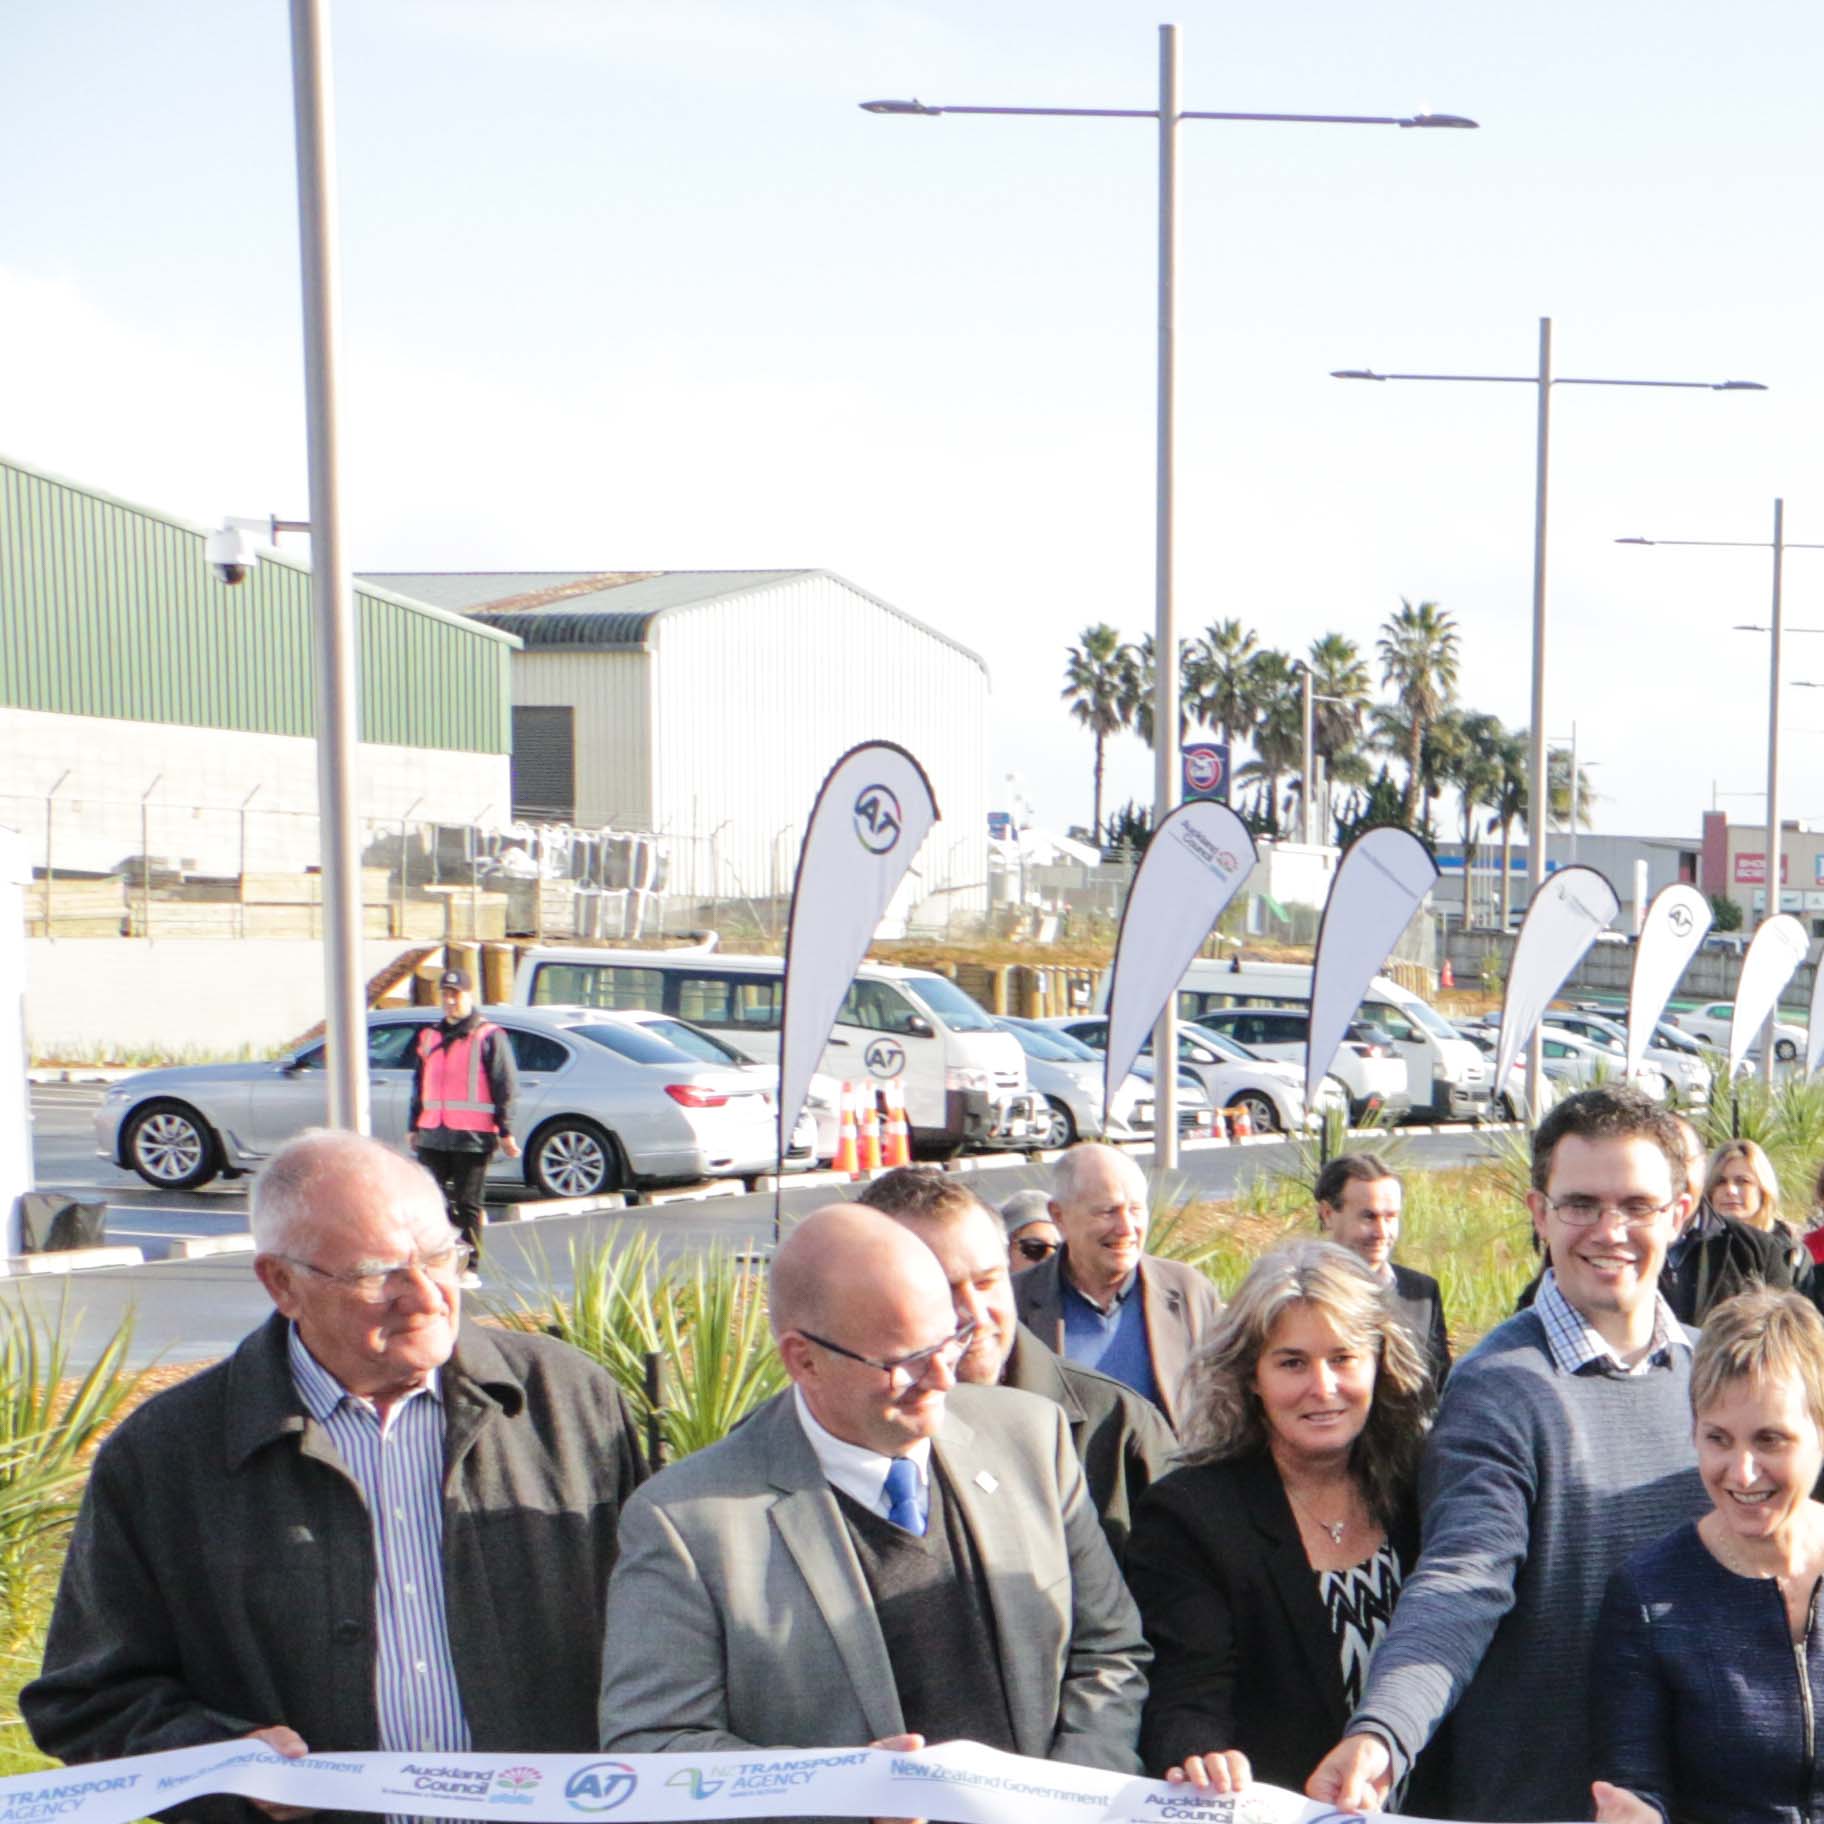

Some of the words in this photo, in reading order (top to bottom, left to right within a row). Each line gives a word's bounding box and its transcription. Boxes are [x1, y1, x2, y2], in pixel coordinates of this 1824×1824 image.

[256, 1751, 366, 1774] Government
[400, 1763, 495, 1781] Auckland
[737, 1752, 872, 1774] TRANSPORT
[6, 1773, 142, 1807] TRANSPORT
[414, 1776, 491, 1795] Council
[731, 1770, 816, 1790] AGENCY
[889, 1759, 931, 1778] New
[931, 1763, 1001, 1790] Zealand
[1002, 1777, 1110, 1807] Government
[0, 1797, 87, 1820] AGENCY
[1143, 1791, 1236, 1811] Auckland
[1161, 1805, 1234, 1824] Council
